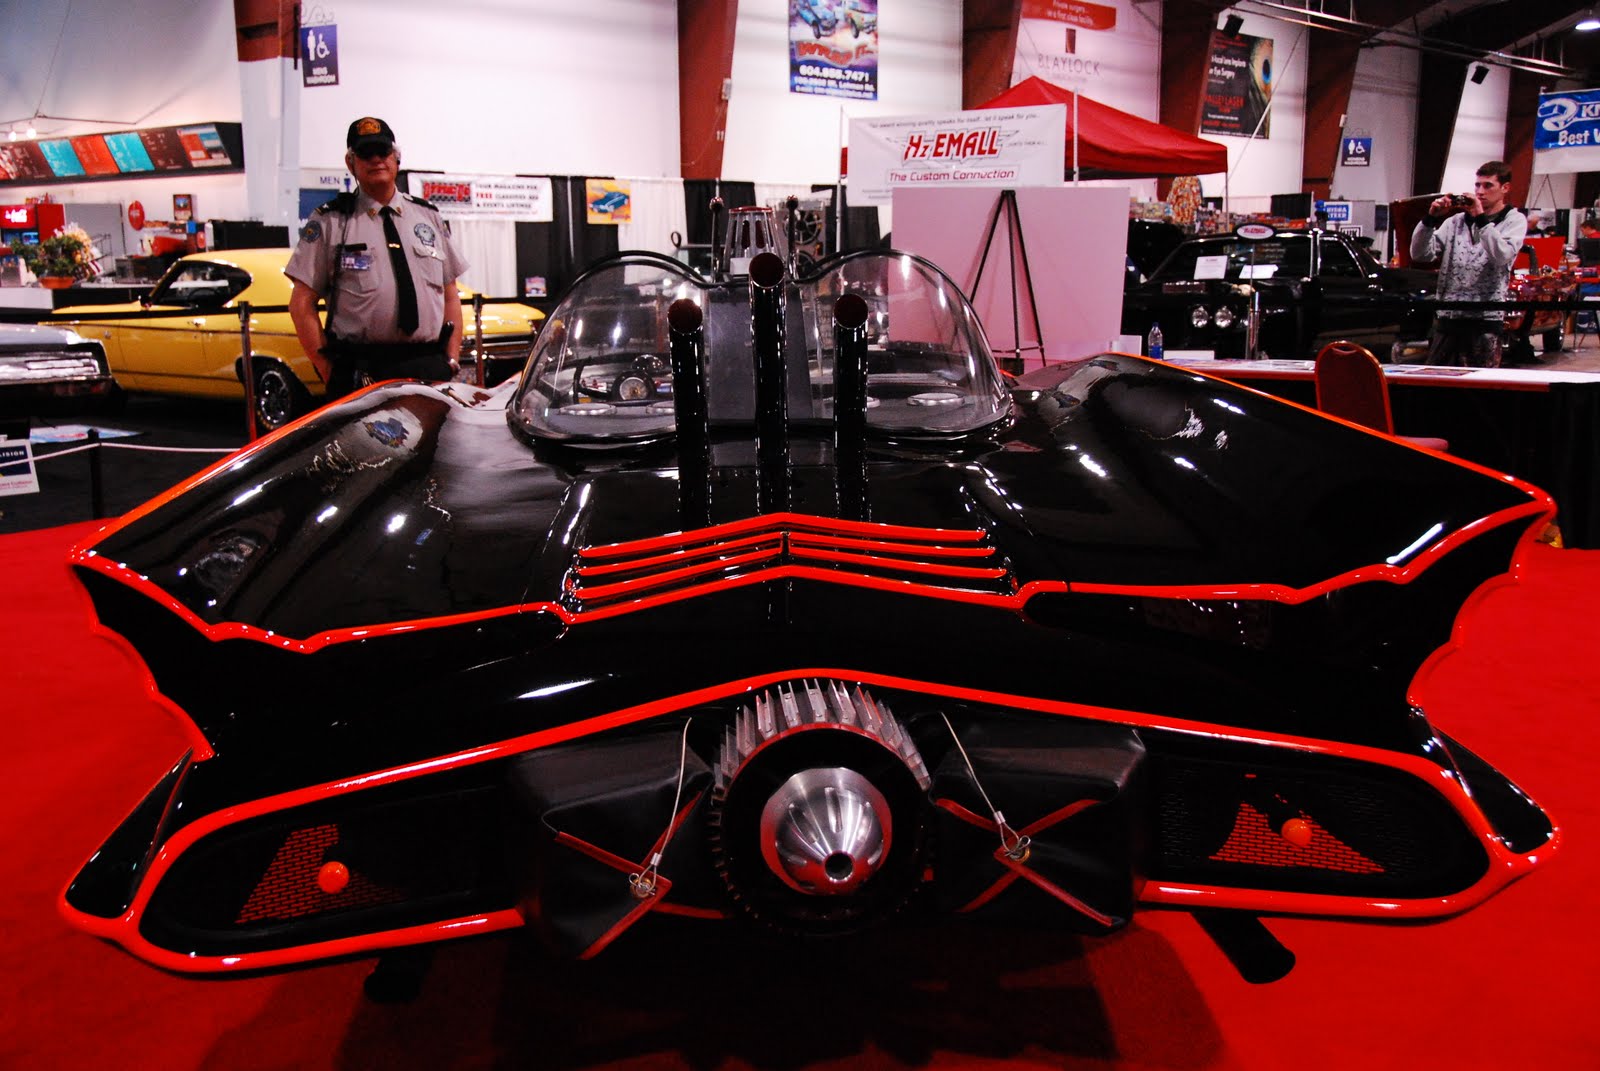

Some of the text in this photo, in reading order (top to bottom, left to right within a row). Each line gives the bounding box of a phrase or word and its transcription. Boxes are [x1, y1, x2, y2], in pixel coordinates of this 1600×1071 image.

[1038, 53, 1100, 76] BLAYLOCK
[1558, 130, 1590, 146] Best
[320, 176, 340, 184] MEN
[890, 172, 907, 181] The
[910, 171, 950, 181] Custom
